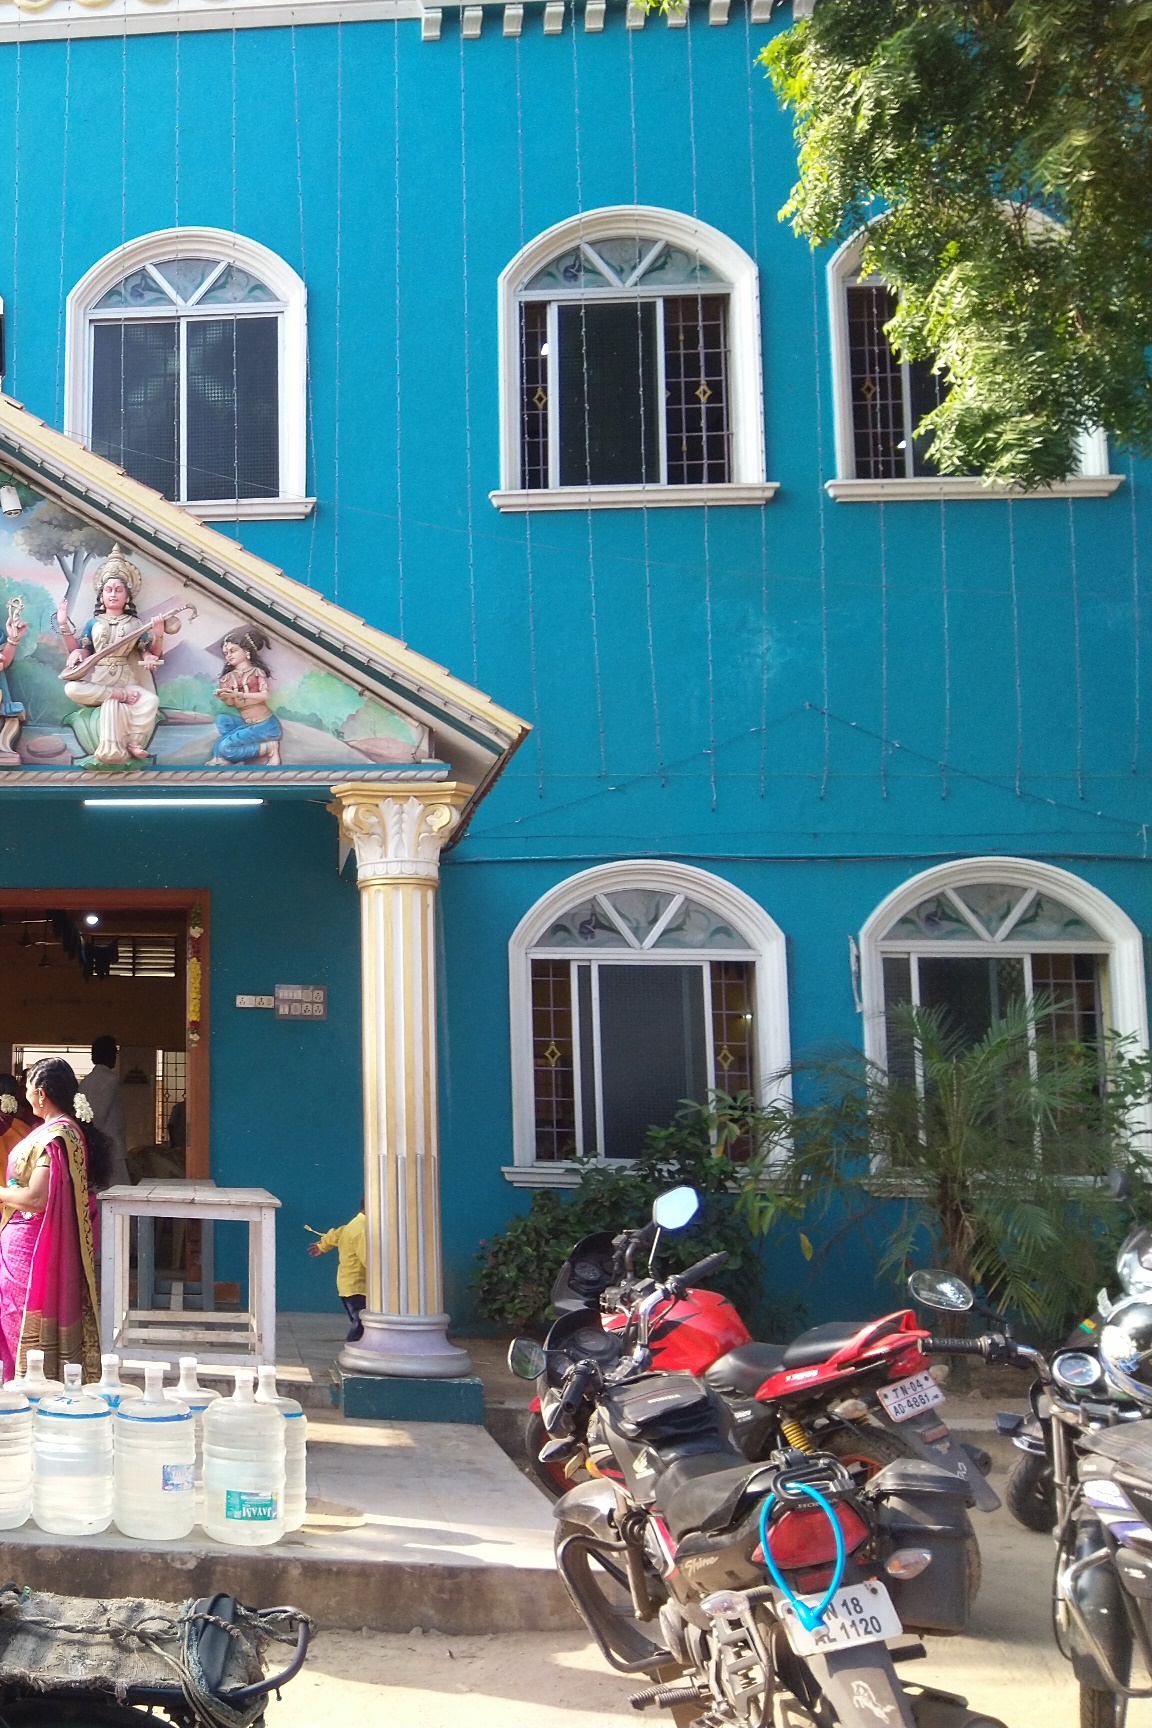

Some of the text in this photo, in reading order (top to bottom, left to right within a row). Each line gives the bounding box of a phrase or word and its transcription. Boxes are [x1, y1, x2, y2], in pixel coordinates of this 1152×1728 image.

[241, 1506, 272, 1518] JAYAM
[684, 1556, 719, 1578] Shine
[841, 1597, 864, 1617] 18
[839, 1615, 882, 1641] 1120
